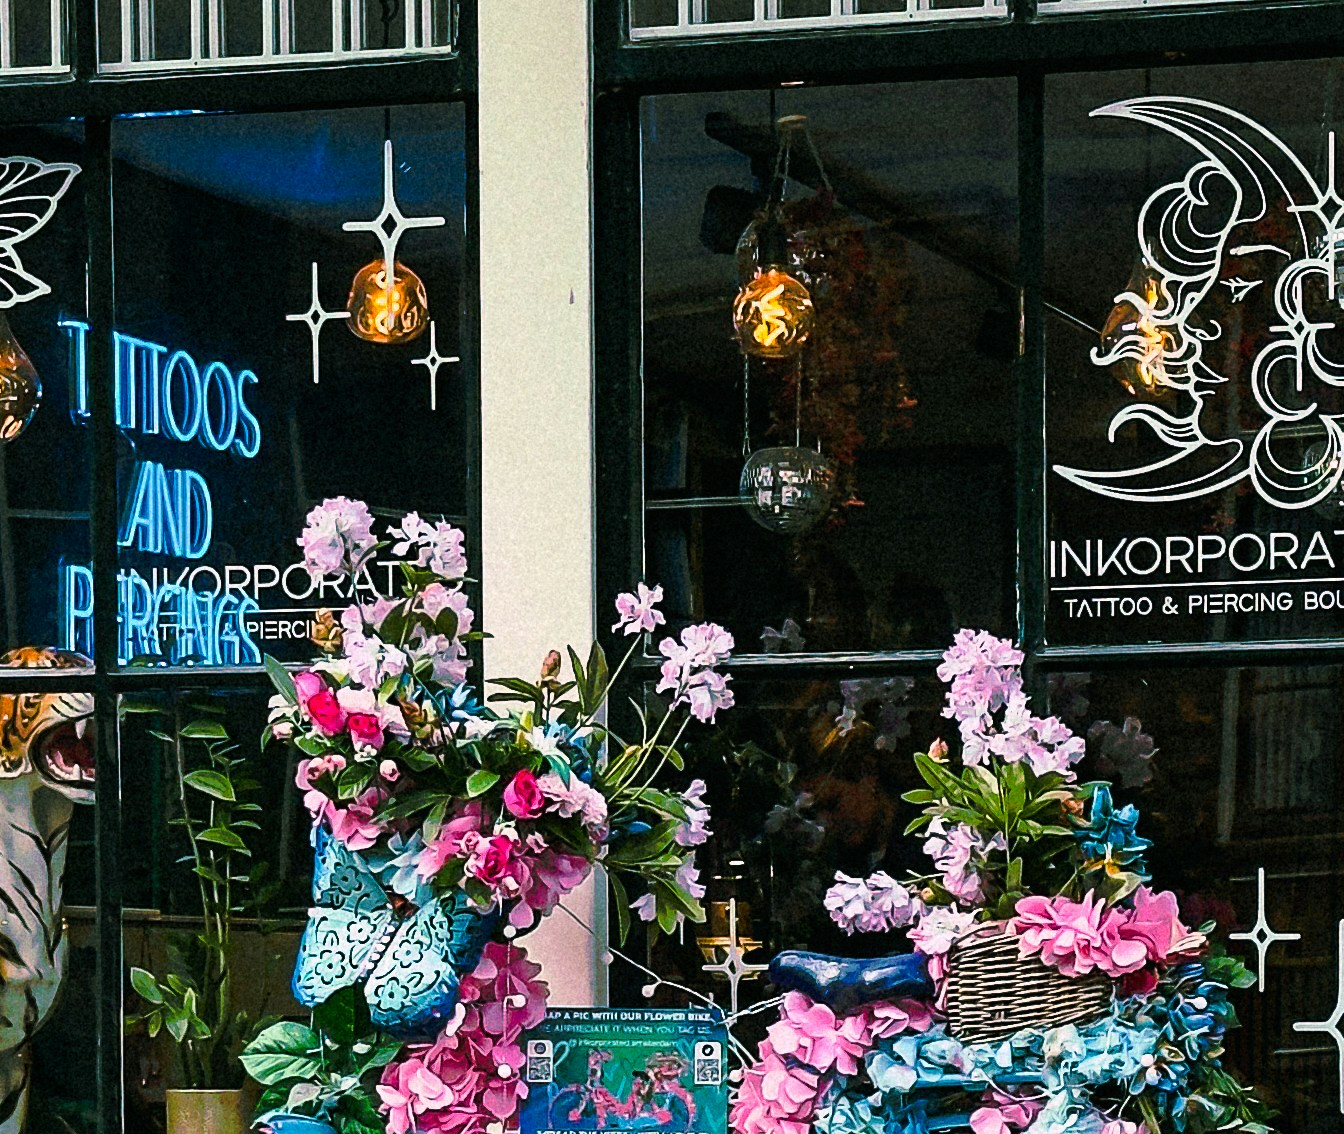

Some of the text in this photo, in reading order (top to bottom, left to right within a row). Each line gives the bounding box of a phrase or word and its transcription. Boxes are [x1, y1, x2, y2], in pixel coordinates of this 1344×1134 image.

[117, 460, 213, 559] AND
[1064, 597, 1153, 618] TATTOO
[1162, 596, 1179, 616] &
[1188, 590, 1294, 615] PIERCING
[564, 1012, 571, 1020] A
[573, 1012, 589, 1020] PIC
[592, 1012, 618, 1020] WITH
[621, 1012, 642, 1020] OUR
[644, 1013, 685, 1021] FLOWER
[656, 1026, 675, 1034] YOU
